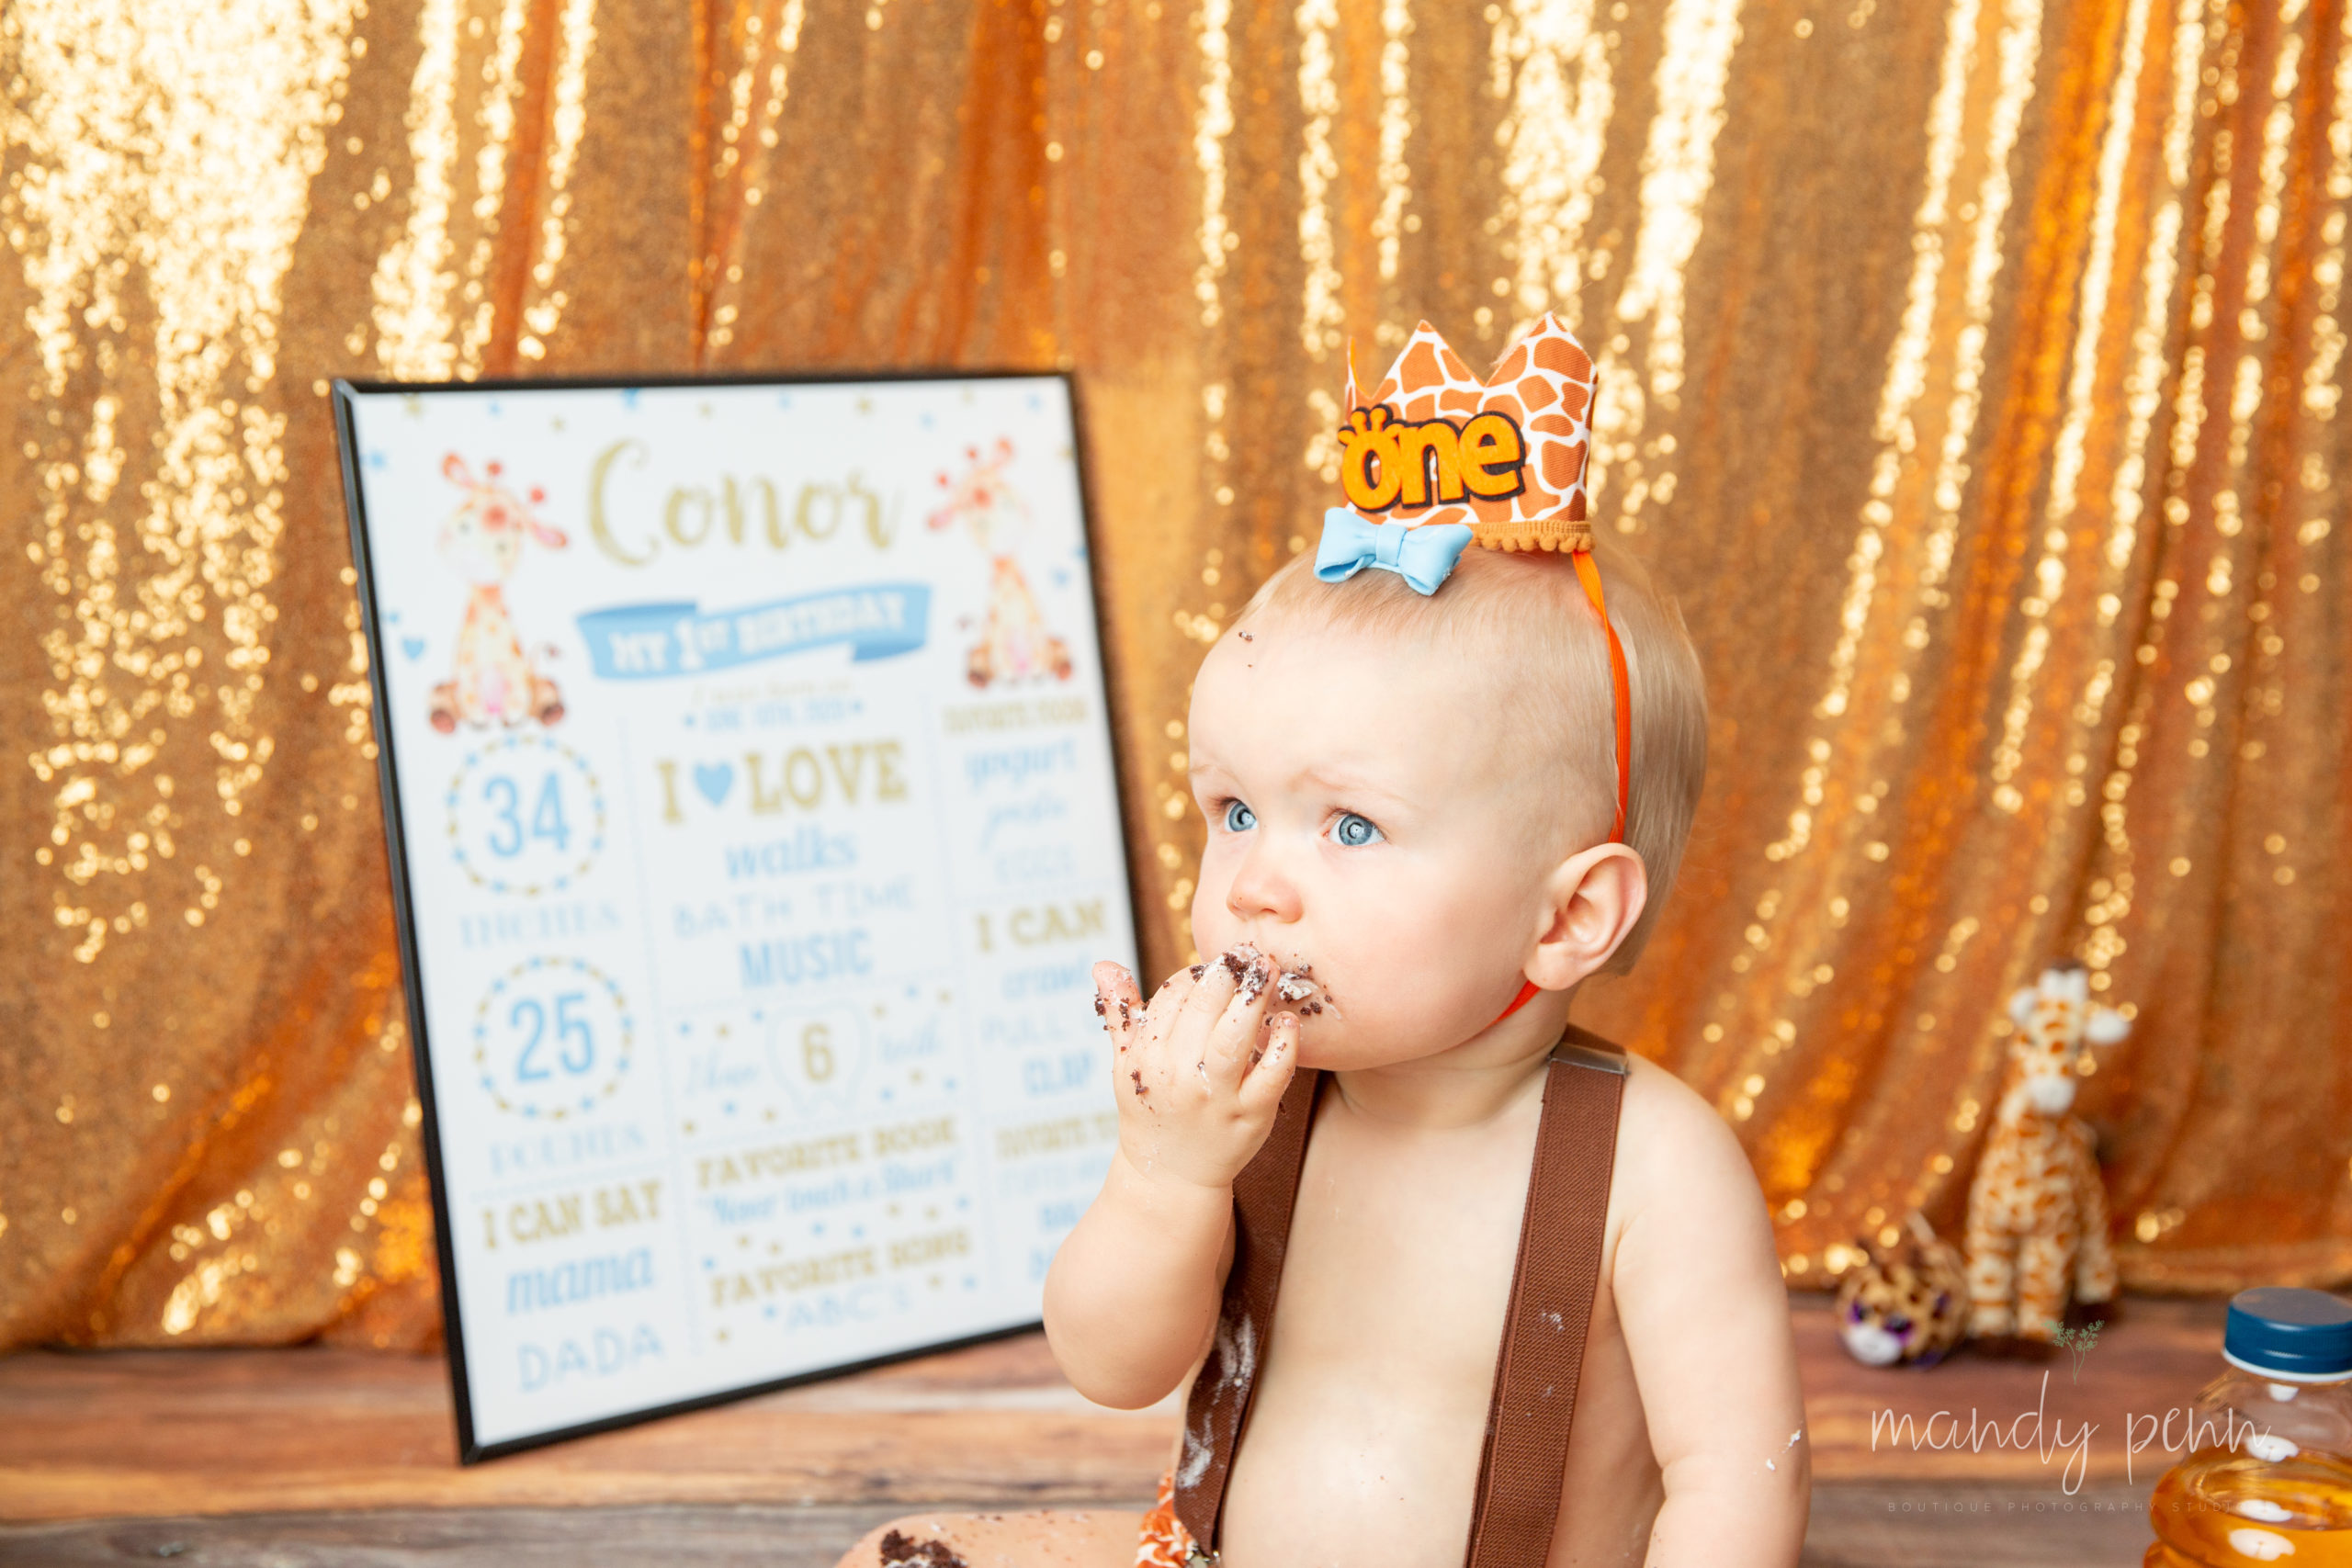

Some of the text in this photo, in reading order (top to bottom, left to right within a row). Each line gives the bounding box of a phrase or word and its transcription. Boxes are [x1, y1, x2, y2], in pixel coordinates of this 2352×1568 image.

[1341, 403, 1526, 513] one
[587, 438, 904, 568] Conor
[609, 631, 670, 671] MY
[736, 592, 908, 655] BIRTHDAY
[483, 771, 571, 859] 34
[657, 739, 909, 825] I LOVE
[724, 823, 859, 882] walks
[673, 873, 917, 940] BATH TIME
[975, 897, 1107, 954] I CAN
[740, 925, 872, 989] MUSIC
[509, 990, 597, 1084] 25
[802, 1021, 836, 1083] 6
[696, 1115, 957, 1190] FAVORITE BOOK
[481, 1178, 662, 1251] I CAN SAY
[506, 1245, 656, 1316] mama
[709, 1247, 879, 1309] FAVORITE
[885, 1226, 972, 1270] SONG
[515, 1322, 666, 1395] DADA
